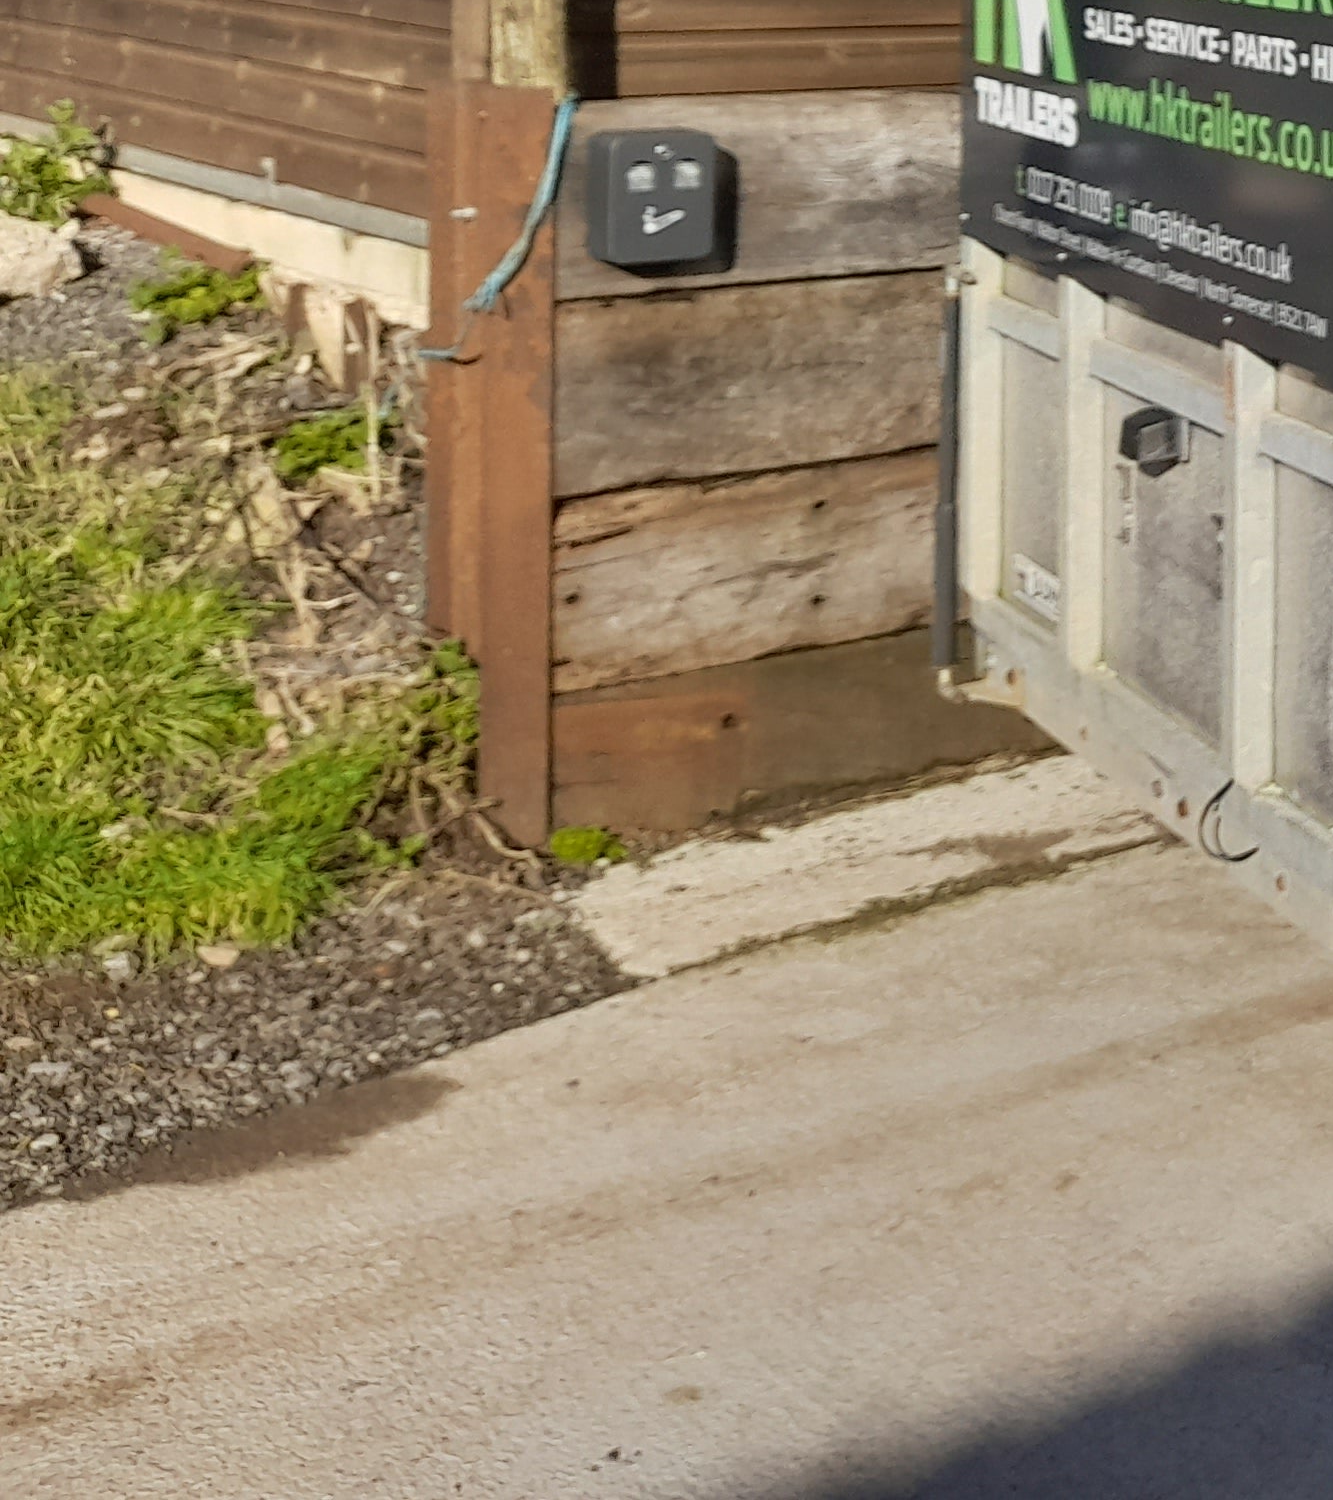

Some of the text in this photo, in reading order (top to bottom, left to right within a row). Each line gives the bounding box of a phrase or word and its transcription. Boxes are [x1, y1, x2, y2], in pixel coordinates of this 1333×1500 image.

[1083, 5, 1137, 48] SALES
[1144, 16, 1222, 63] SERVICE
[1231, 30, 1298, 77] PARTS
[973, 74, 1079, 148] TRAILERS
